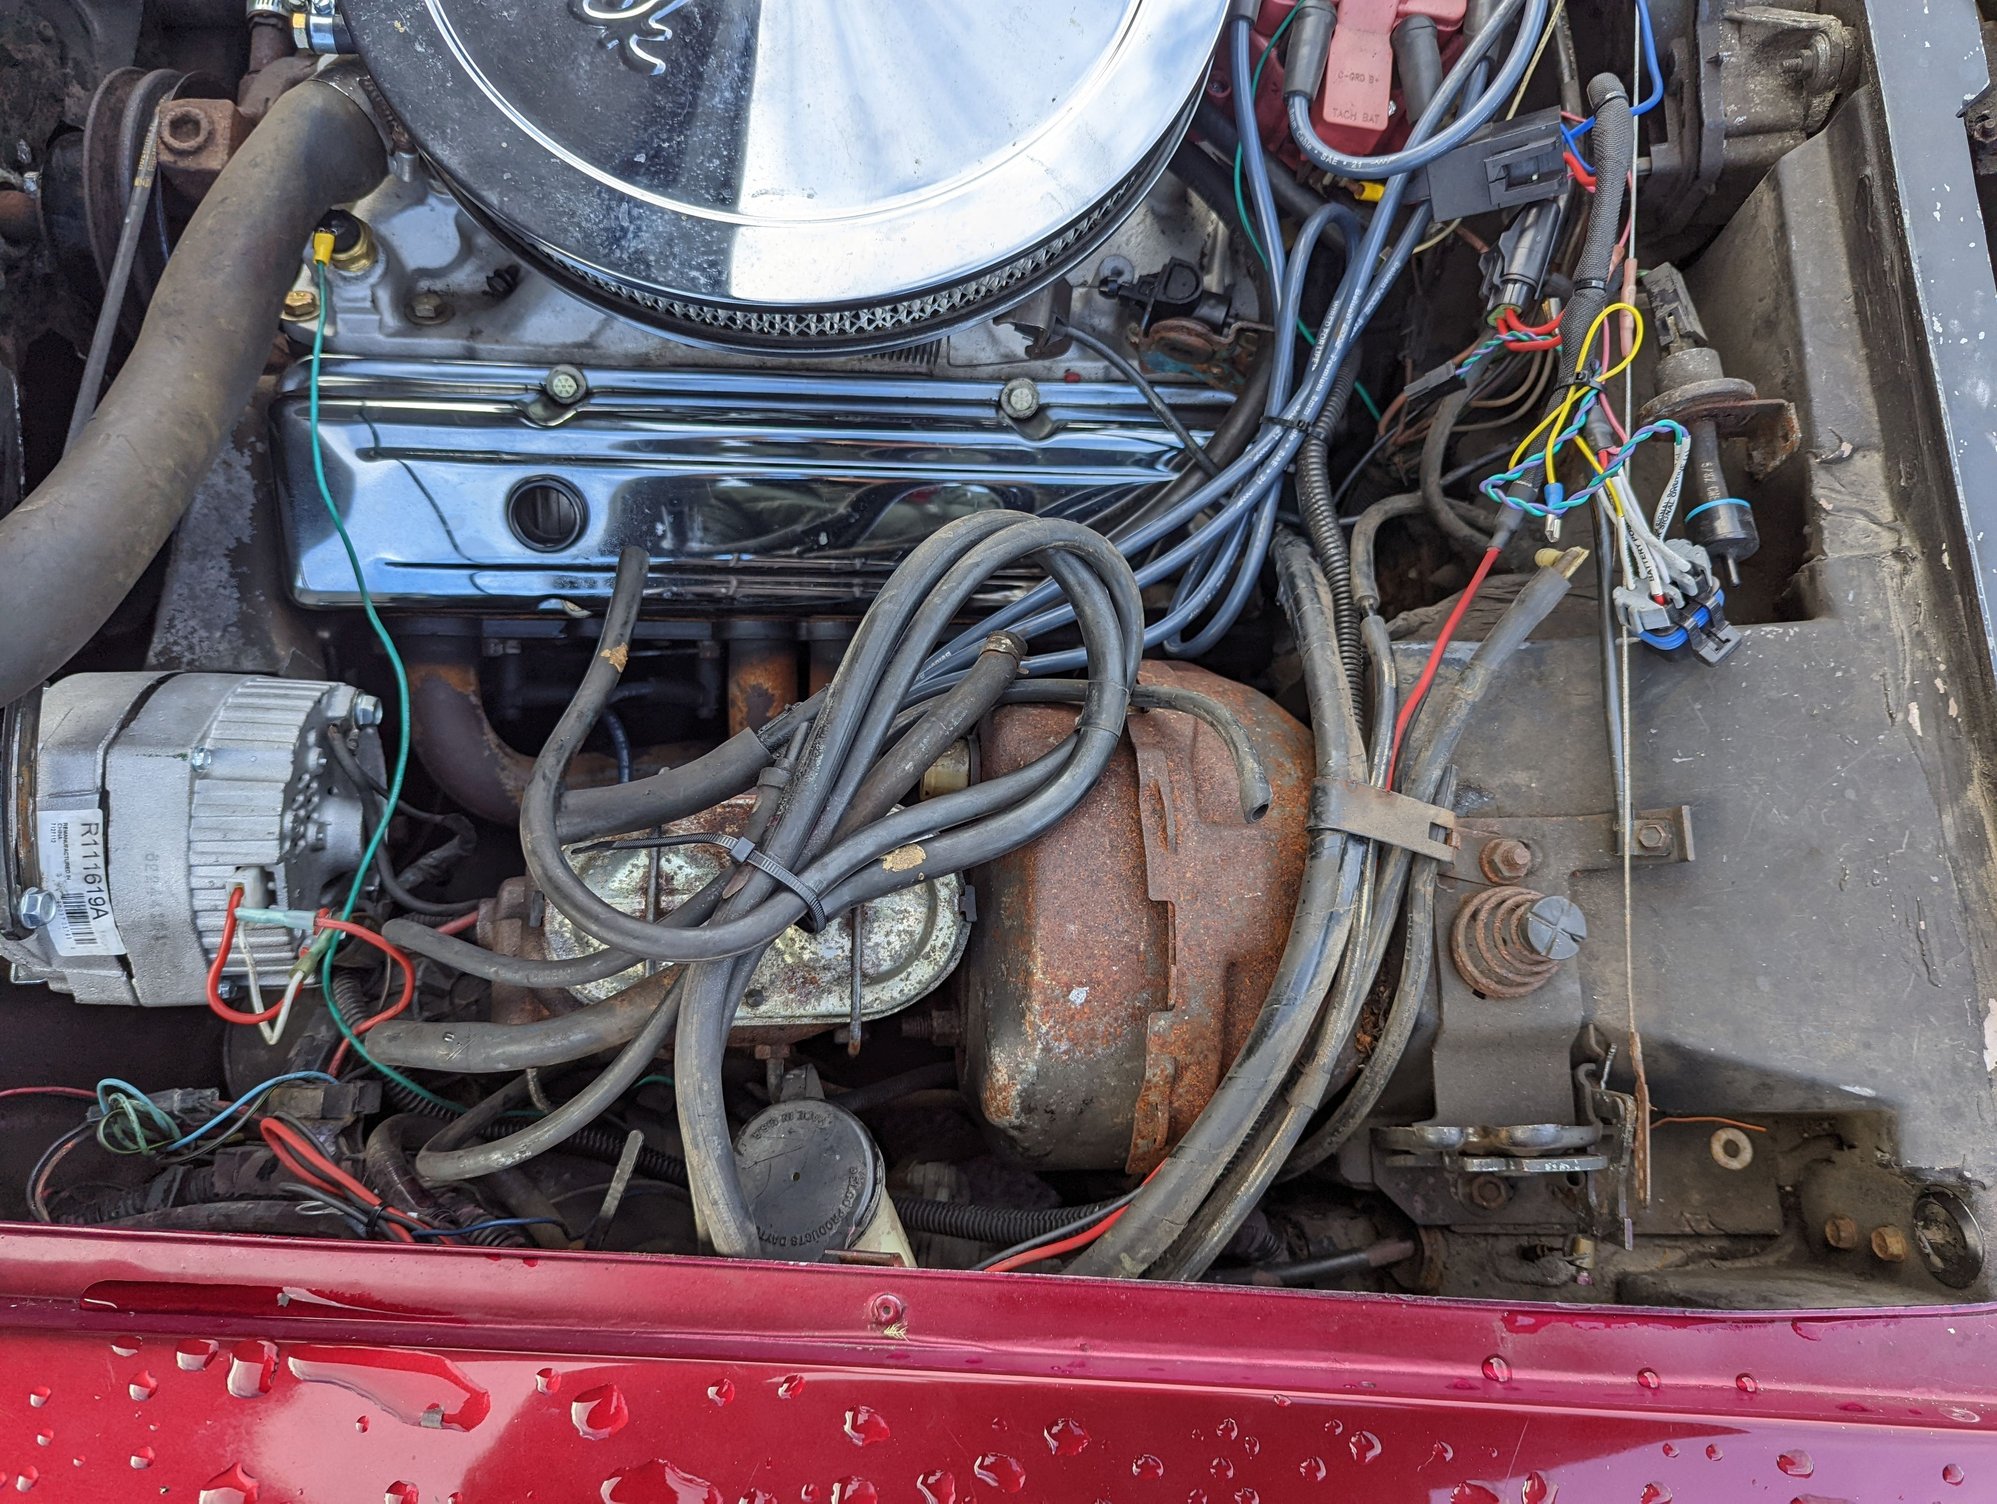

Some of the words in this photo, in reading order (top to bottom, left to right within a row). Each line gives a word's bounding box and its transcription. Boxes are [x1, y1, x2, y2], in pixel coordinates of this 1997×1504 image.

[1332, 107, 1357, 121] TACH
[1362, 113, 1380, 124] BAT
[1296, 130, 1313, 151] Cable
[1320, 153, 1339, 165] SAE
[1325, 300, 1341, 328] WIRED
[1316, 327, 1332, 346] FOR
[1314, 353, 1338, 393] Premium
[1270, 450, 1286, 468] SAE
[80, 822, 109, 920] R111619A
[790, 1207, 846, 1248] PRODUCTS
